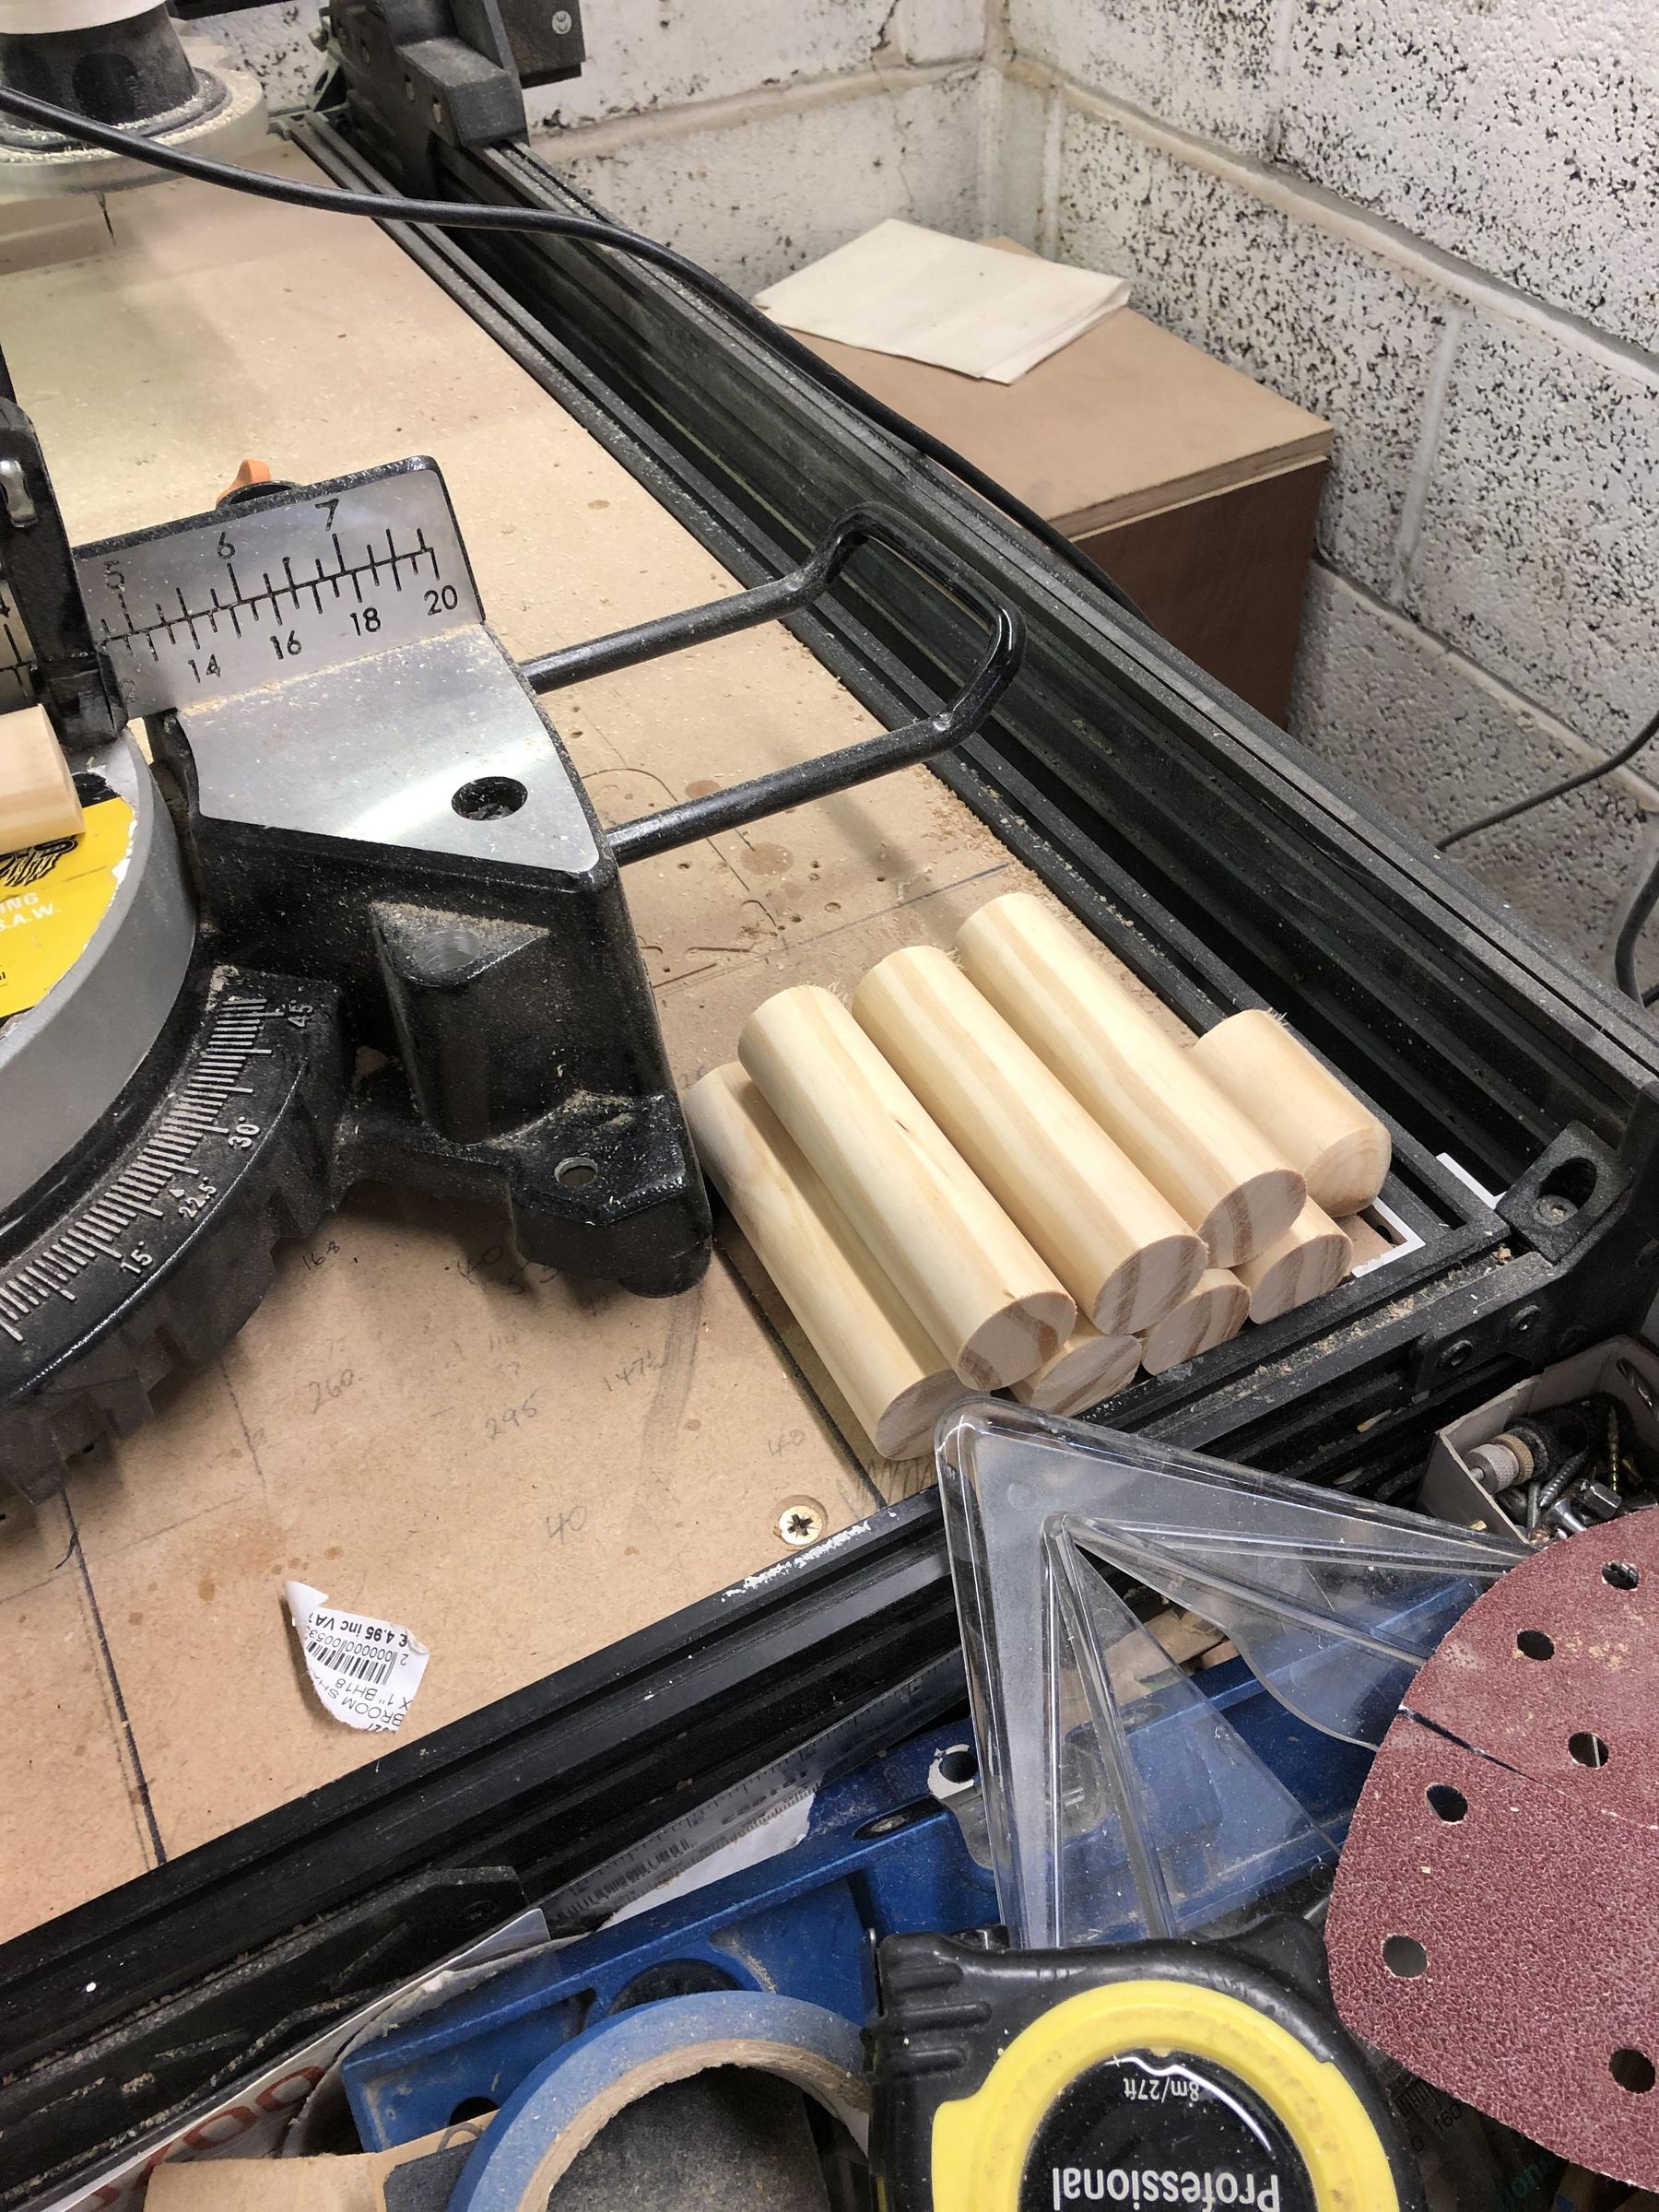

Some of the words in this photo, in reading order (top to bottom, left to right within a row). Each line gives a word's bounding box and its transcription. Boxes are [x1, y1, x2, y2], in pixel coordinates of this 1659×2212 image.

[104, 559, 125, 591] 5
[218, 532, 236, 559] 6
[315, 498, 339, 532] 7
[188, 654, 221, 683] 14
[270, 629, 302, 660] 16
[349, 607, 382, 636] 18
[424, 584, 458, 616] 20
[340, 1620, 362, 1638] inc
[364, 1626, 394, 1644] 4.95
[335, 1677, 378, 1701] BH18
[341, 1696, 405, 1727] BROOM
[1124, 2076, 1199, 2102] 8m/27ft
[1052, 2167, 1280, 2212] Professional
